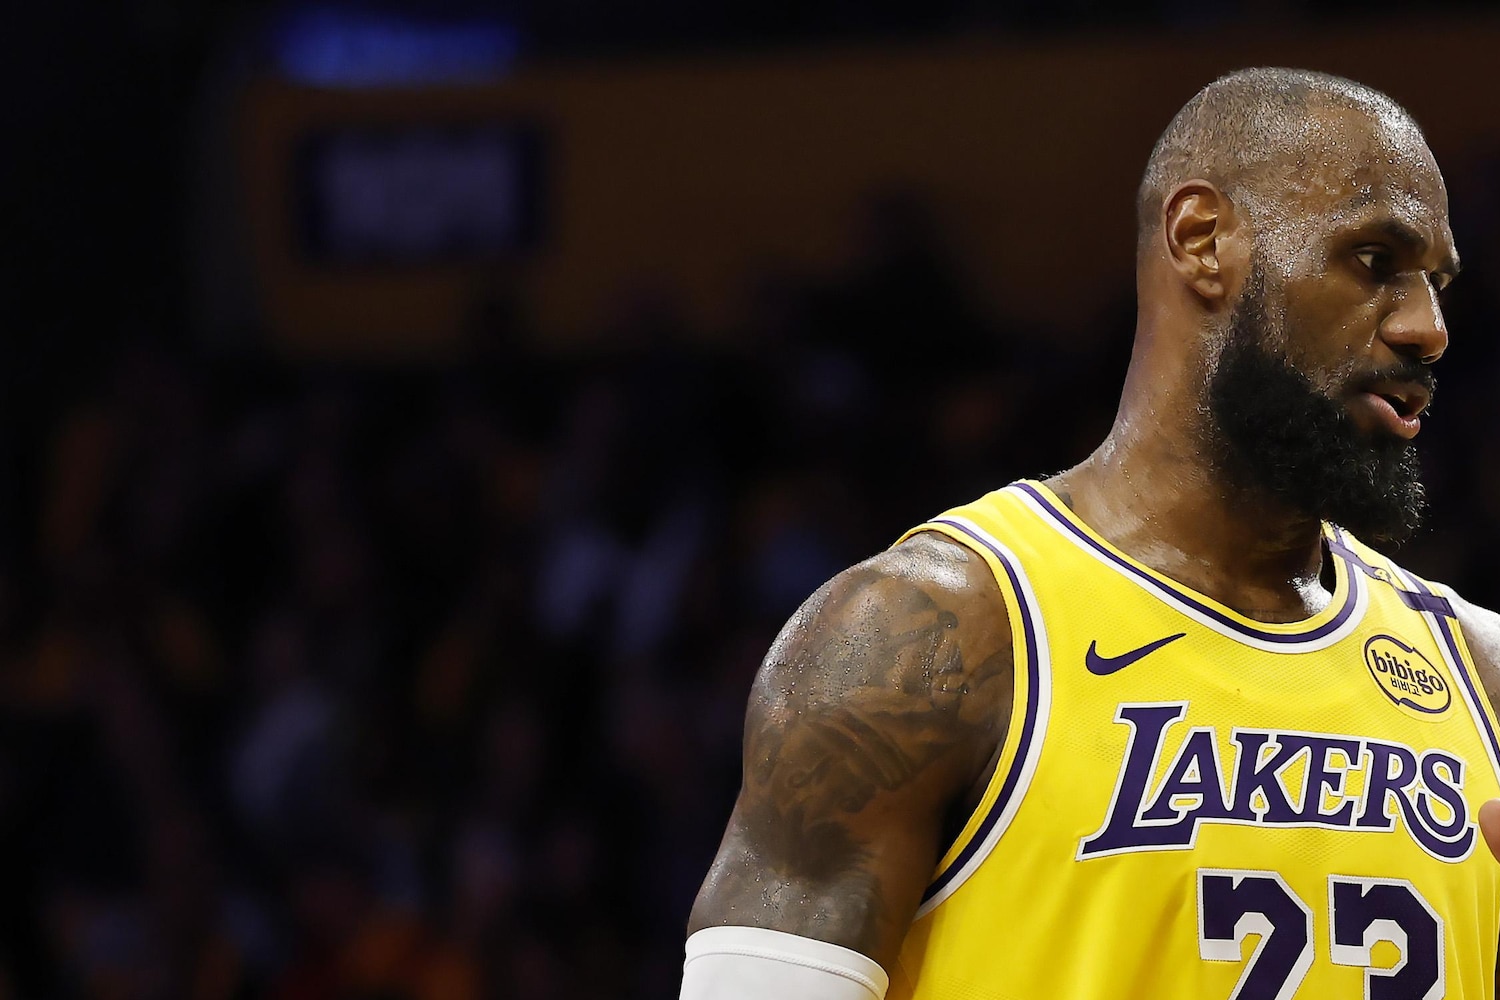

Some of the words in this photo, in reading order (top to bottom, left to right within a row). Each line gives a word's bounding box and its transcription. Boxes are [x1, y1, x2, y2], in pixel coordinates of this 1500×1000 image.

[1370, 649, 1444, 695] bibigo
[1390, 676, 1422, 697] 비비고
[1076, 701, 1478, 863] LAKERS
